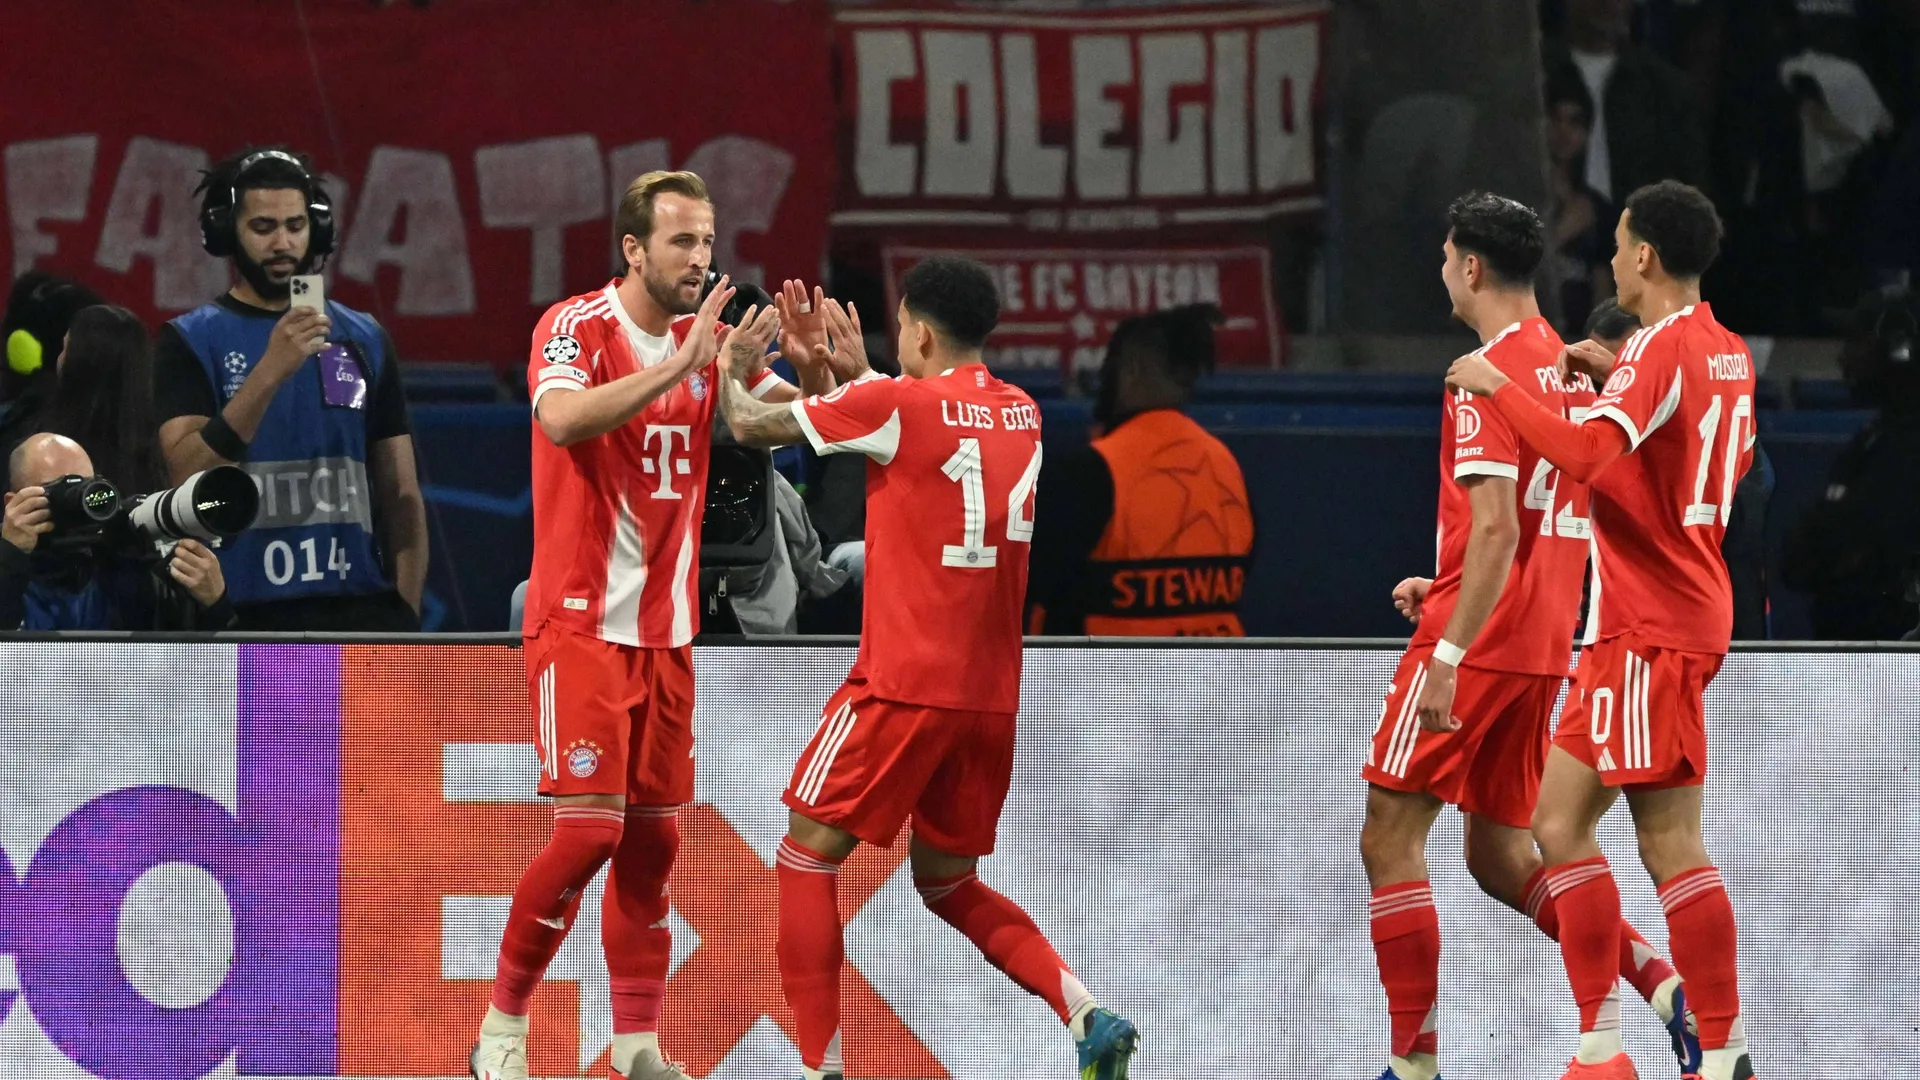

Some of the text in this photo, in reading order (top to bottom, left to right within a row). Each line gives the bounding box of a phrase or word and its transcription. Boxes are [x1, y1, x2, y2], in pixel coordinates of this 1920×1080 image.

[853, 22, 1320, 199] COLEGIO
[4, 133, 798, 316] FAATC
[941, 399, 994, 430] LUIS
[263, 537, 352, 586] 014
[940, 438, 1043, 568] 14
